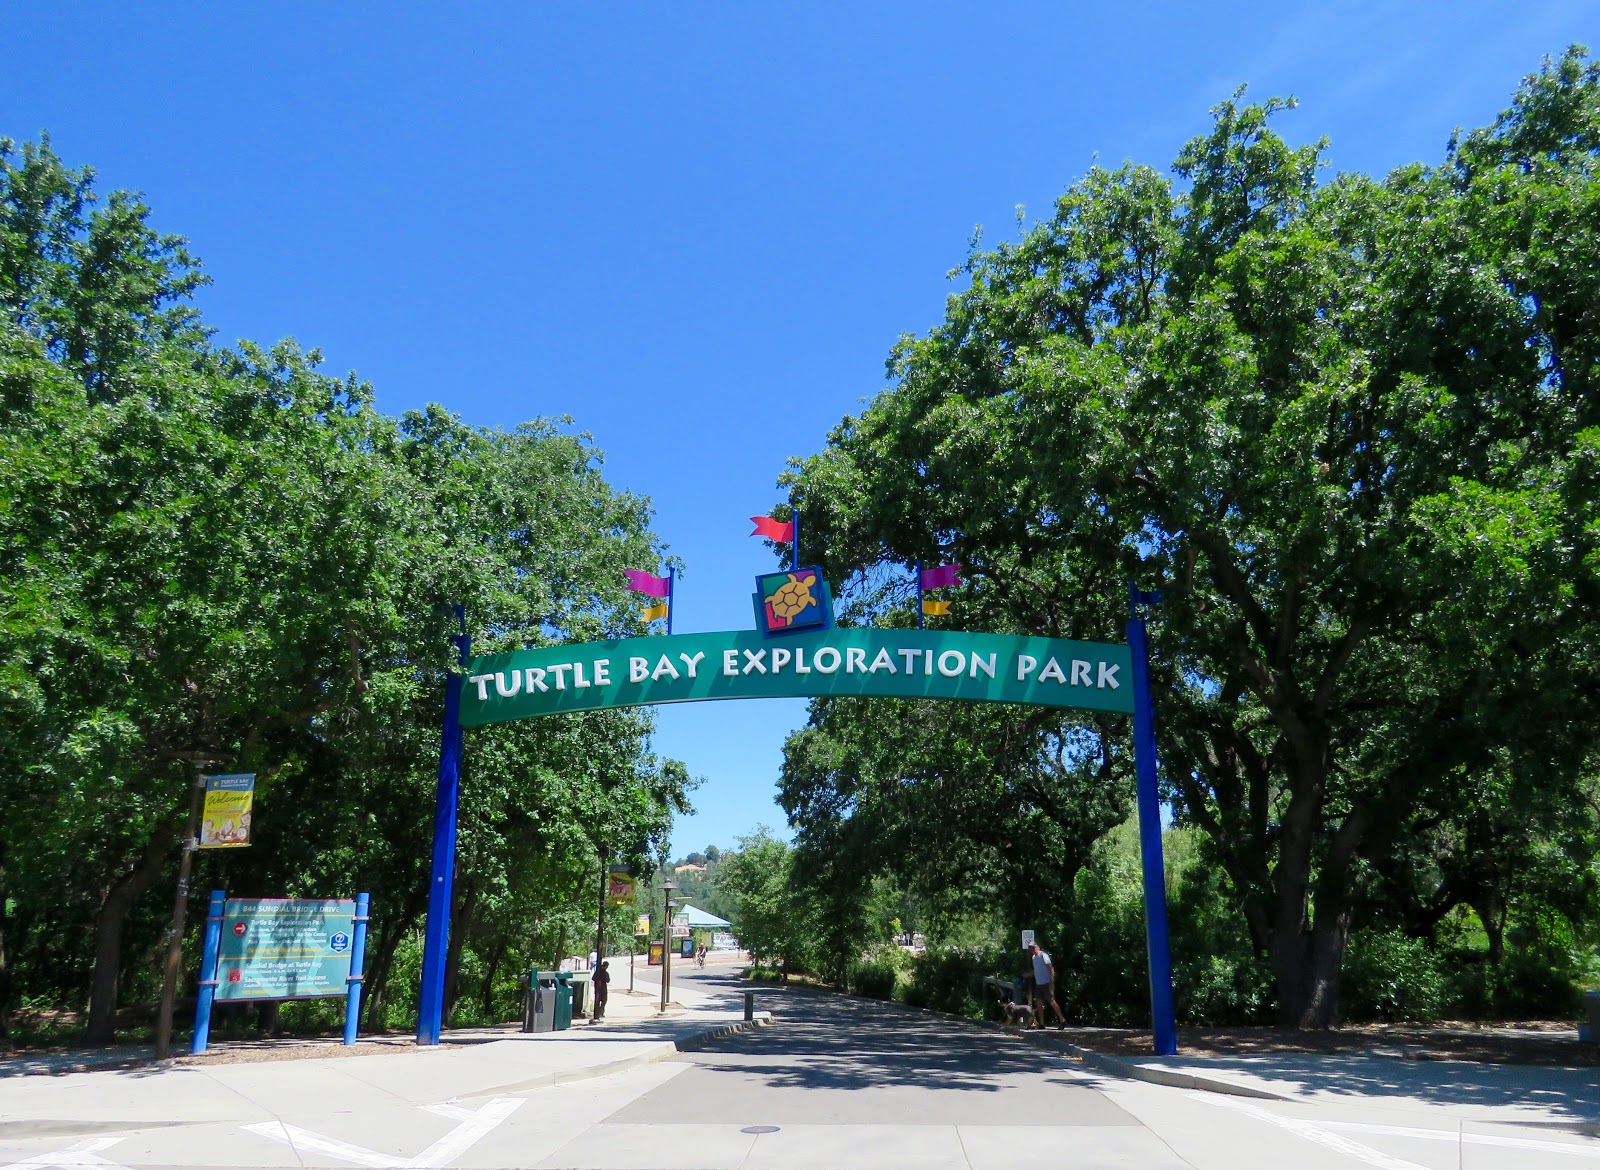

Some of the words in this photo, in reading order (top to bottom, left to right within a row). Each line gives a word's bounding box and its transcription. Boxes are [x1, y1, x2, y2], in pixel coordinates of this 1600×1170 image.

[469, 659, 612, 701] TURTLE
[629, 651, 705, 683] BAY
[723, 646, 997, 679] EXPLORATION
[1017, 655, 1121, 690] PARK
[268, 919, 279, 927] Bay
